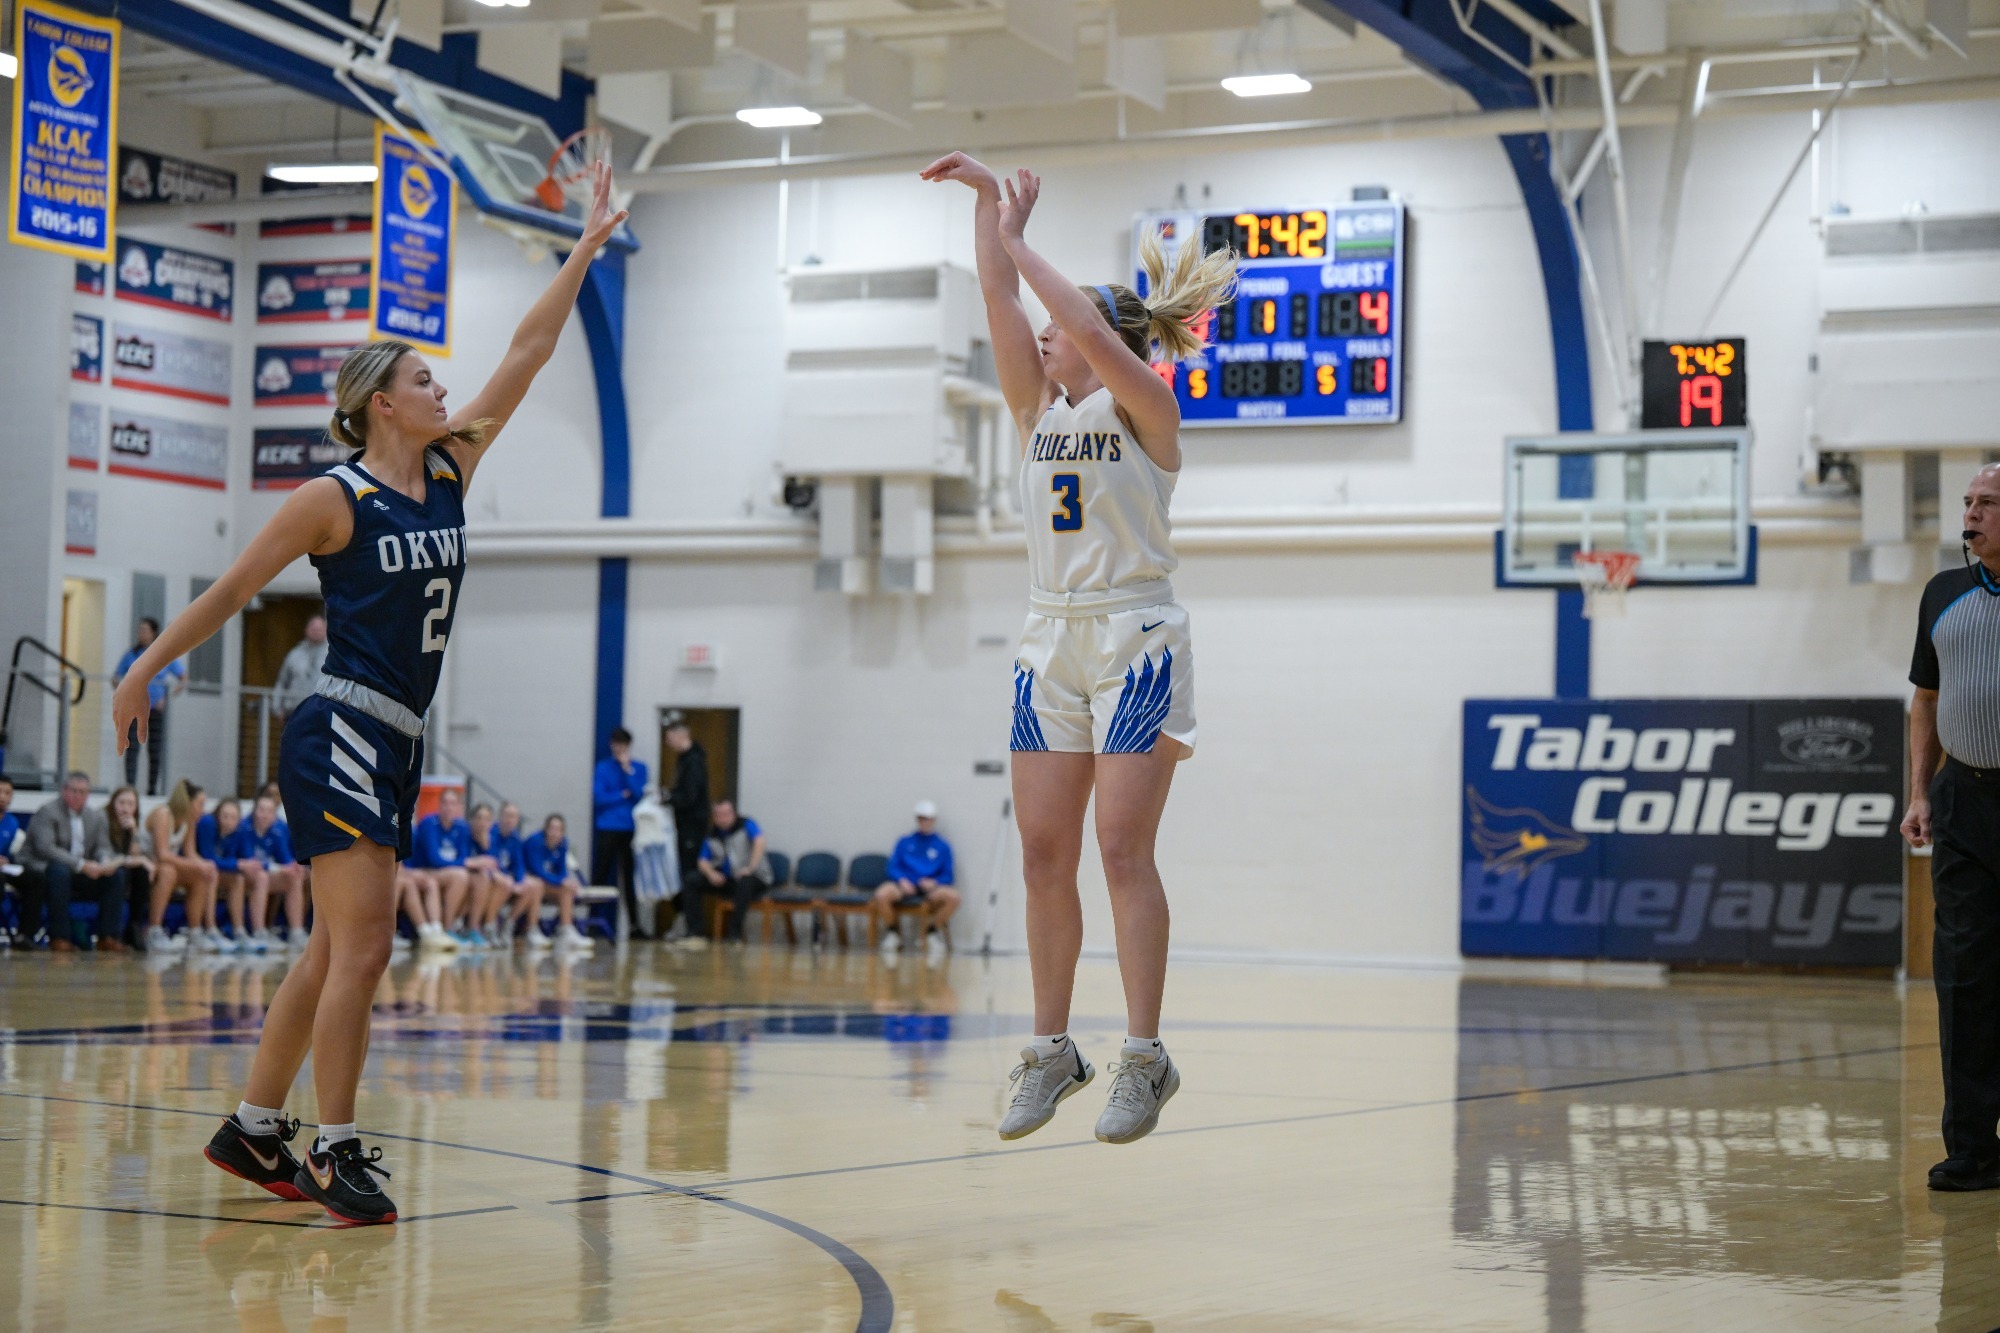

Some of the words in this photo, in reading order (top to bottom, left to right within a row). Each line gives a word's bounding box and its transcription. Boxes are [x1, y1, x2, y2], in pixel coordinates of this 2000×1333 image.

[38, 120, 92, 157] KCAC
[31, 205, 97, 239] 2015-16
[1234, 211, 1327, 259] 7:42
[1239, 277, 1289, 297] PERIOD
[1321, 261, 1388, 289] GUEST
[1263, 300, 1276, 333] 1
[1359, 291, 1389, 335] 4
[1216, 342, 1268, 362] PLAYER
[1272, 341, 1308, 361] FOUL
[1346, 338, 1392, 359] FOULS
[1669, 343, 1735, 376] 7:42
[1188, 367, 1208, 399] 5
[1316, 364, 1337, 395] 5
[1374, 358, 1387, 393] 1
[1680, 375, 1723, 428] 19
[1051, 472, 1084, 534] 3
[377, 525, 468, 573] OKW
[421, 577, 452, 654] 2
[1488, 714, 1737, 773] Tabor
[1570, 777, 1896, 851] College
[1462, 860, 1901, 949] Bluejays
